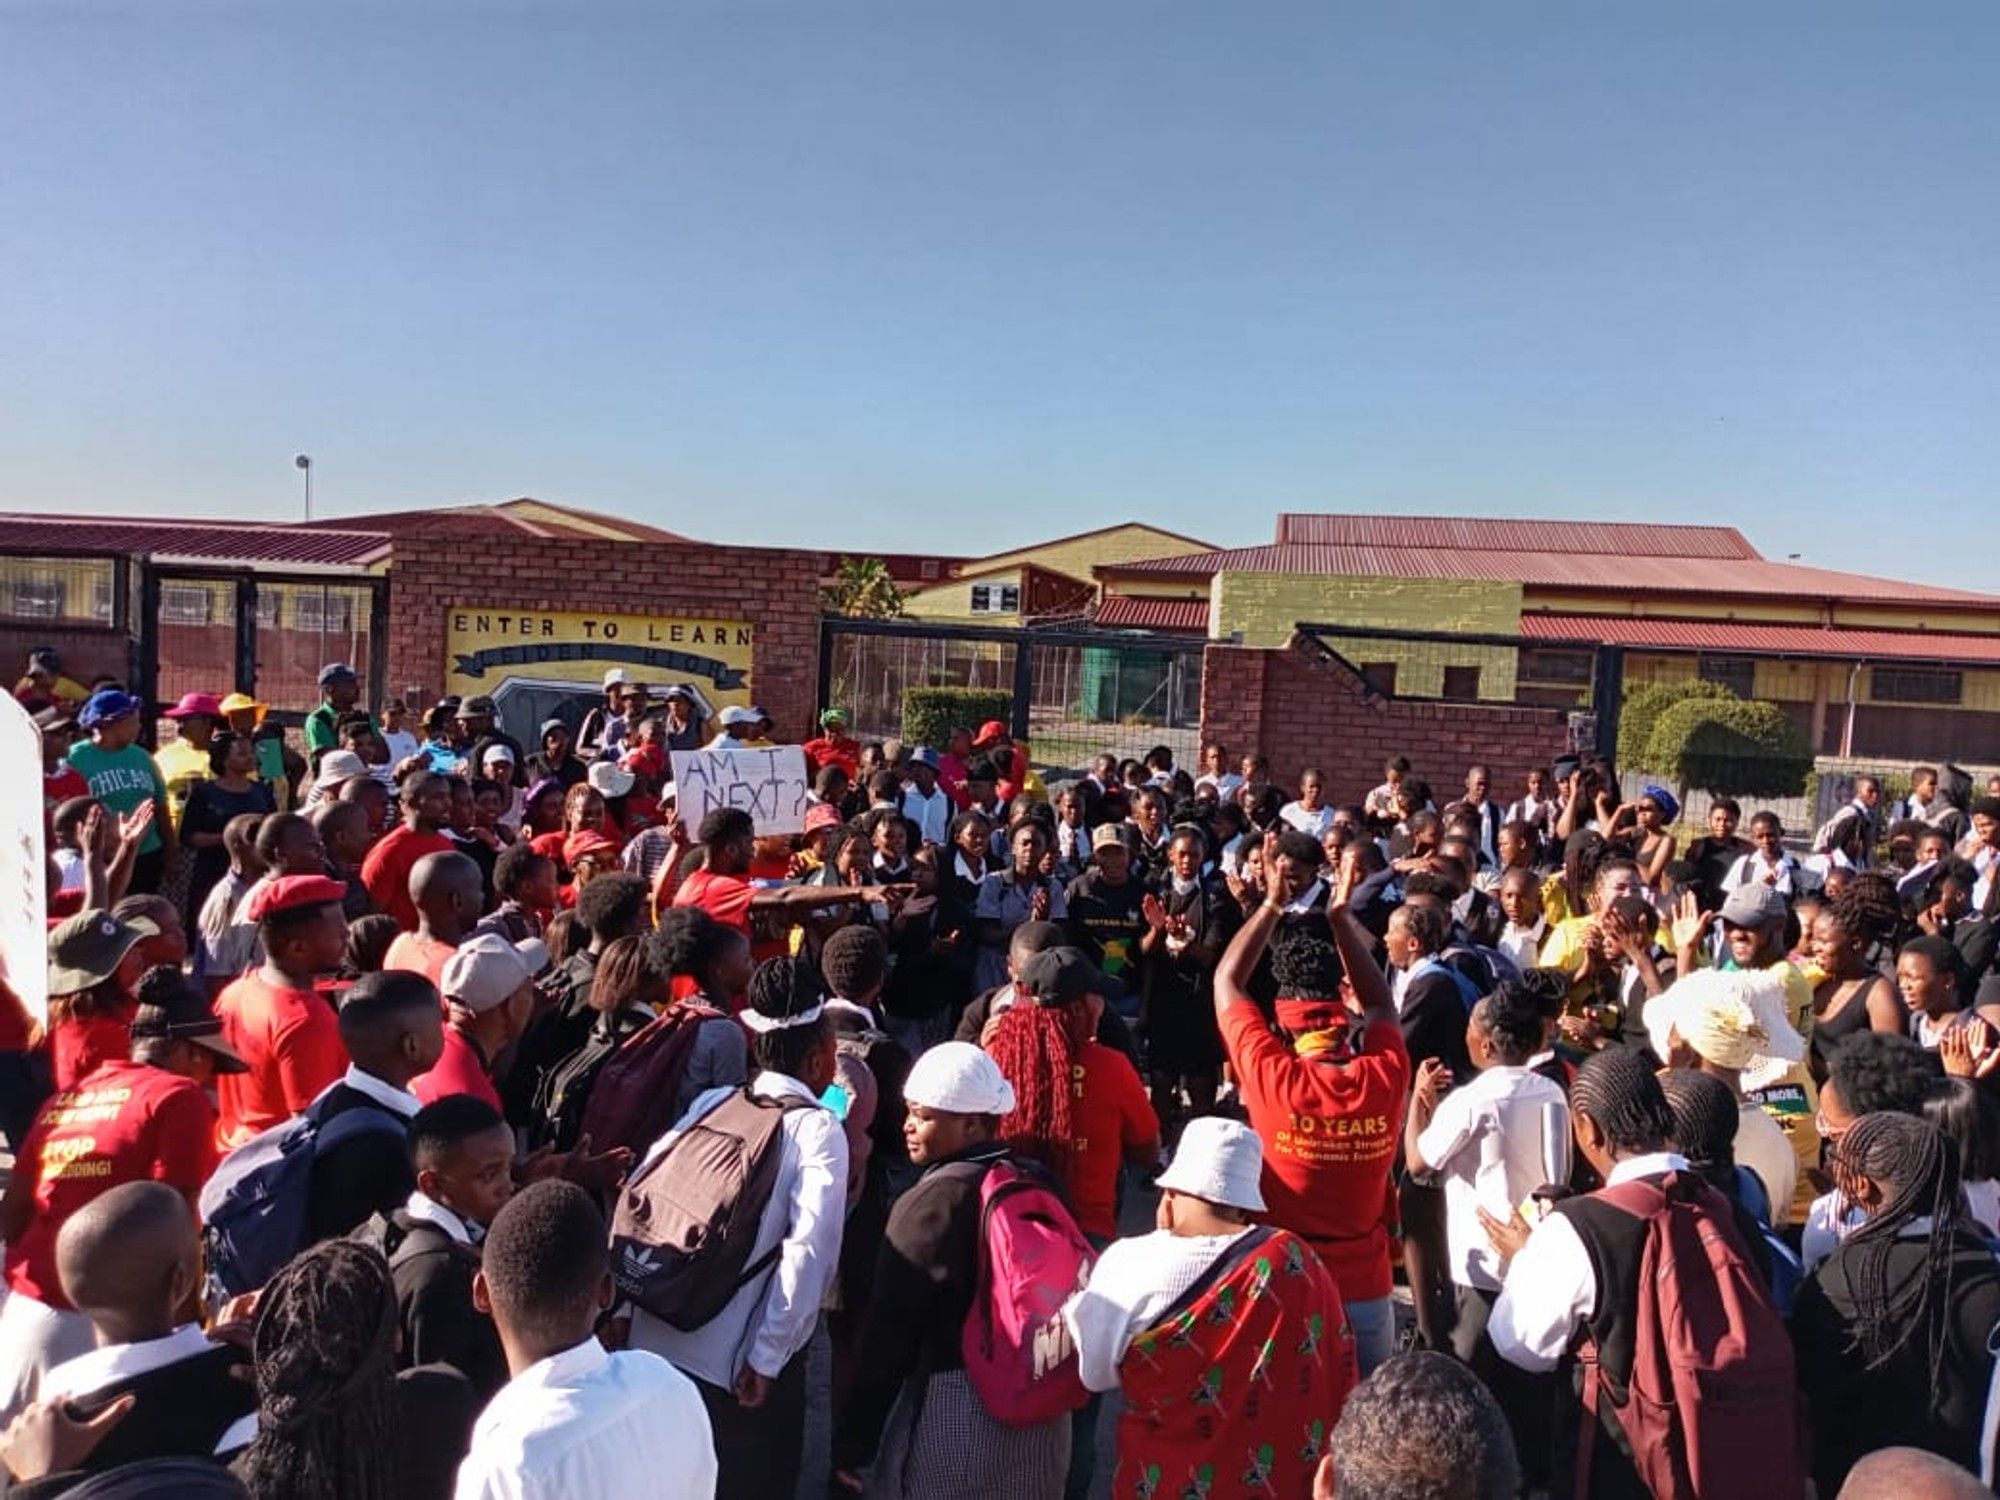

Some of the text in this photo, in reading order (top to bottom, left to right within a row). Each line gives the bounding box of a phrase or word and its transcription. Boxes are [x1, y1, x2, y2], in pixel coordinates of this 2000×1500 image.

[455, 614, 749, 646] ENTER TO LEARN
[683, 748, 783, 788] AM I
[703, 779, 805, 820] NEXT?
[1288, 1113, 1388, 1137] 10 YEARS
